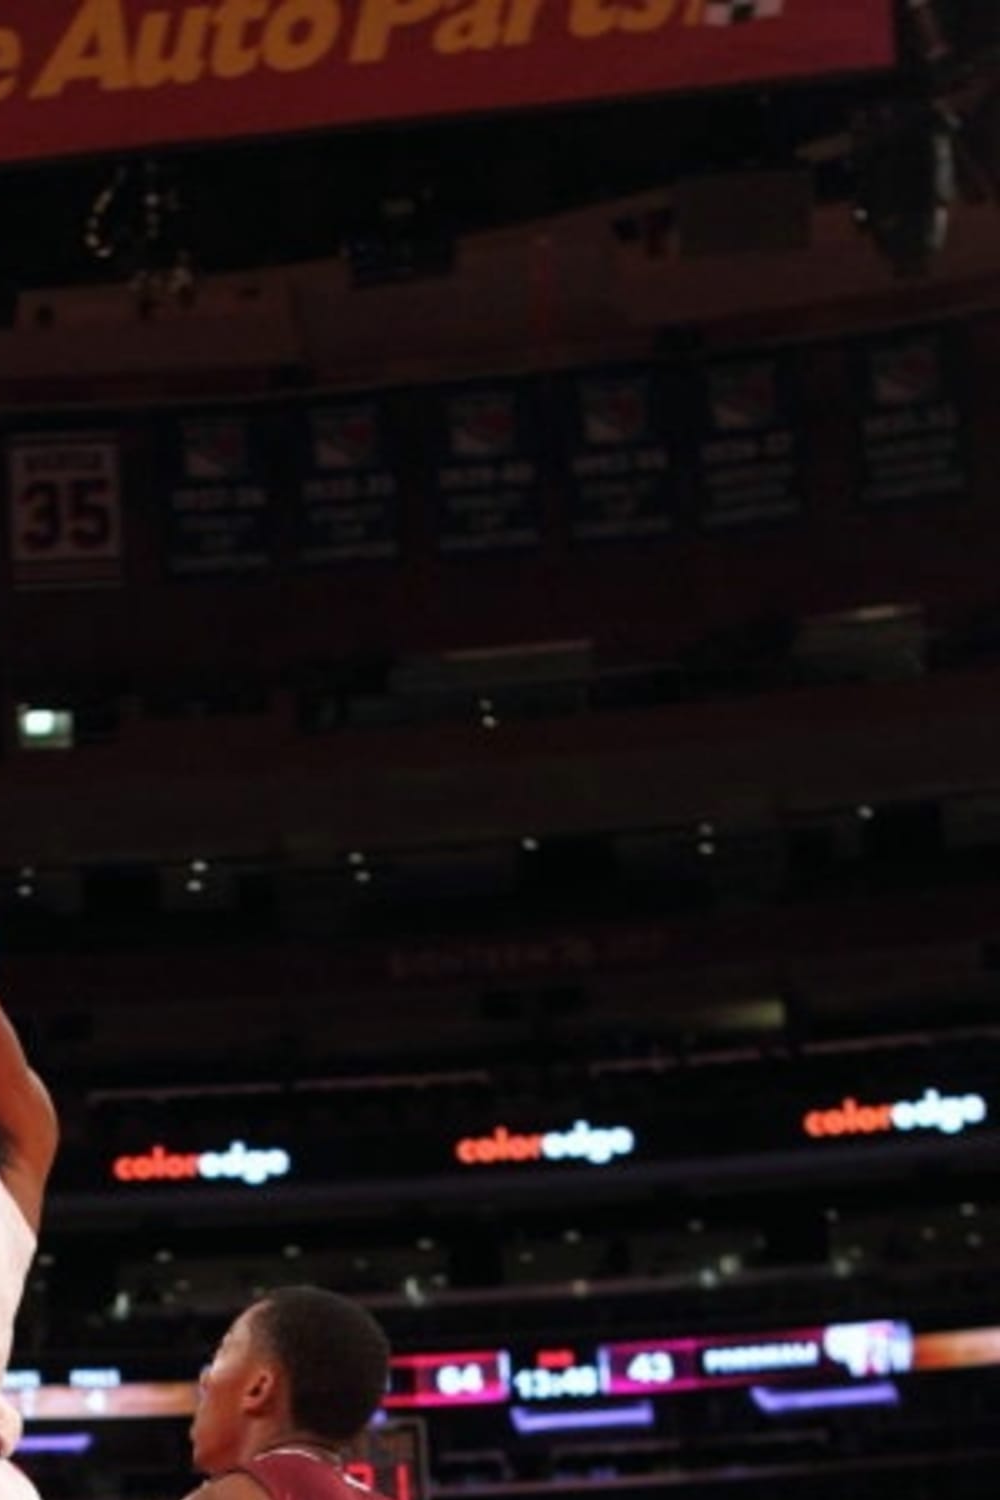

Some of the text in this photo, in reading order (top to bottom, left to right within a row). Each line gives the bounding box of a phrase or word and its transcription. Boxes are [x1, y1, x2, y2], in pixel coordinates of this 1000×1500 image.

[31, 0, 340, 98] Auto
[20, 476, 112, 552] 35
[803, 1089, 985, 1136] coloredge
[114, 1141, 289, 1184] coloredge
[457, 1120, 634, 1162] coloredge
[628, 1352, 673, 1382] 43
